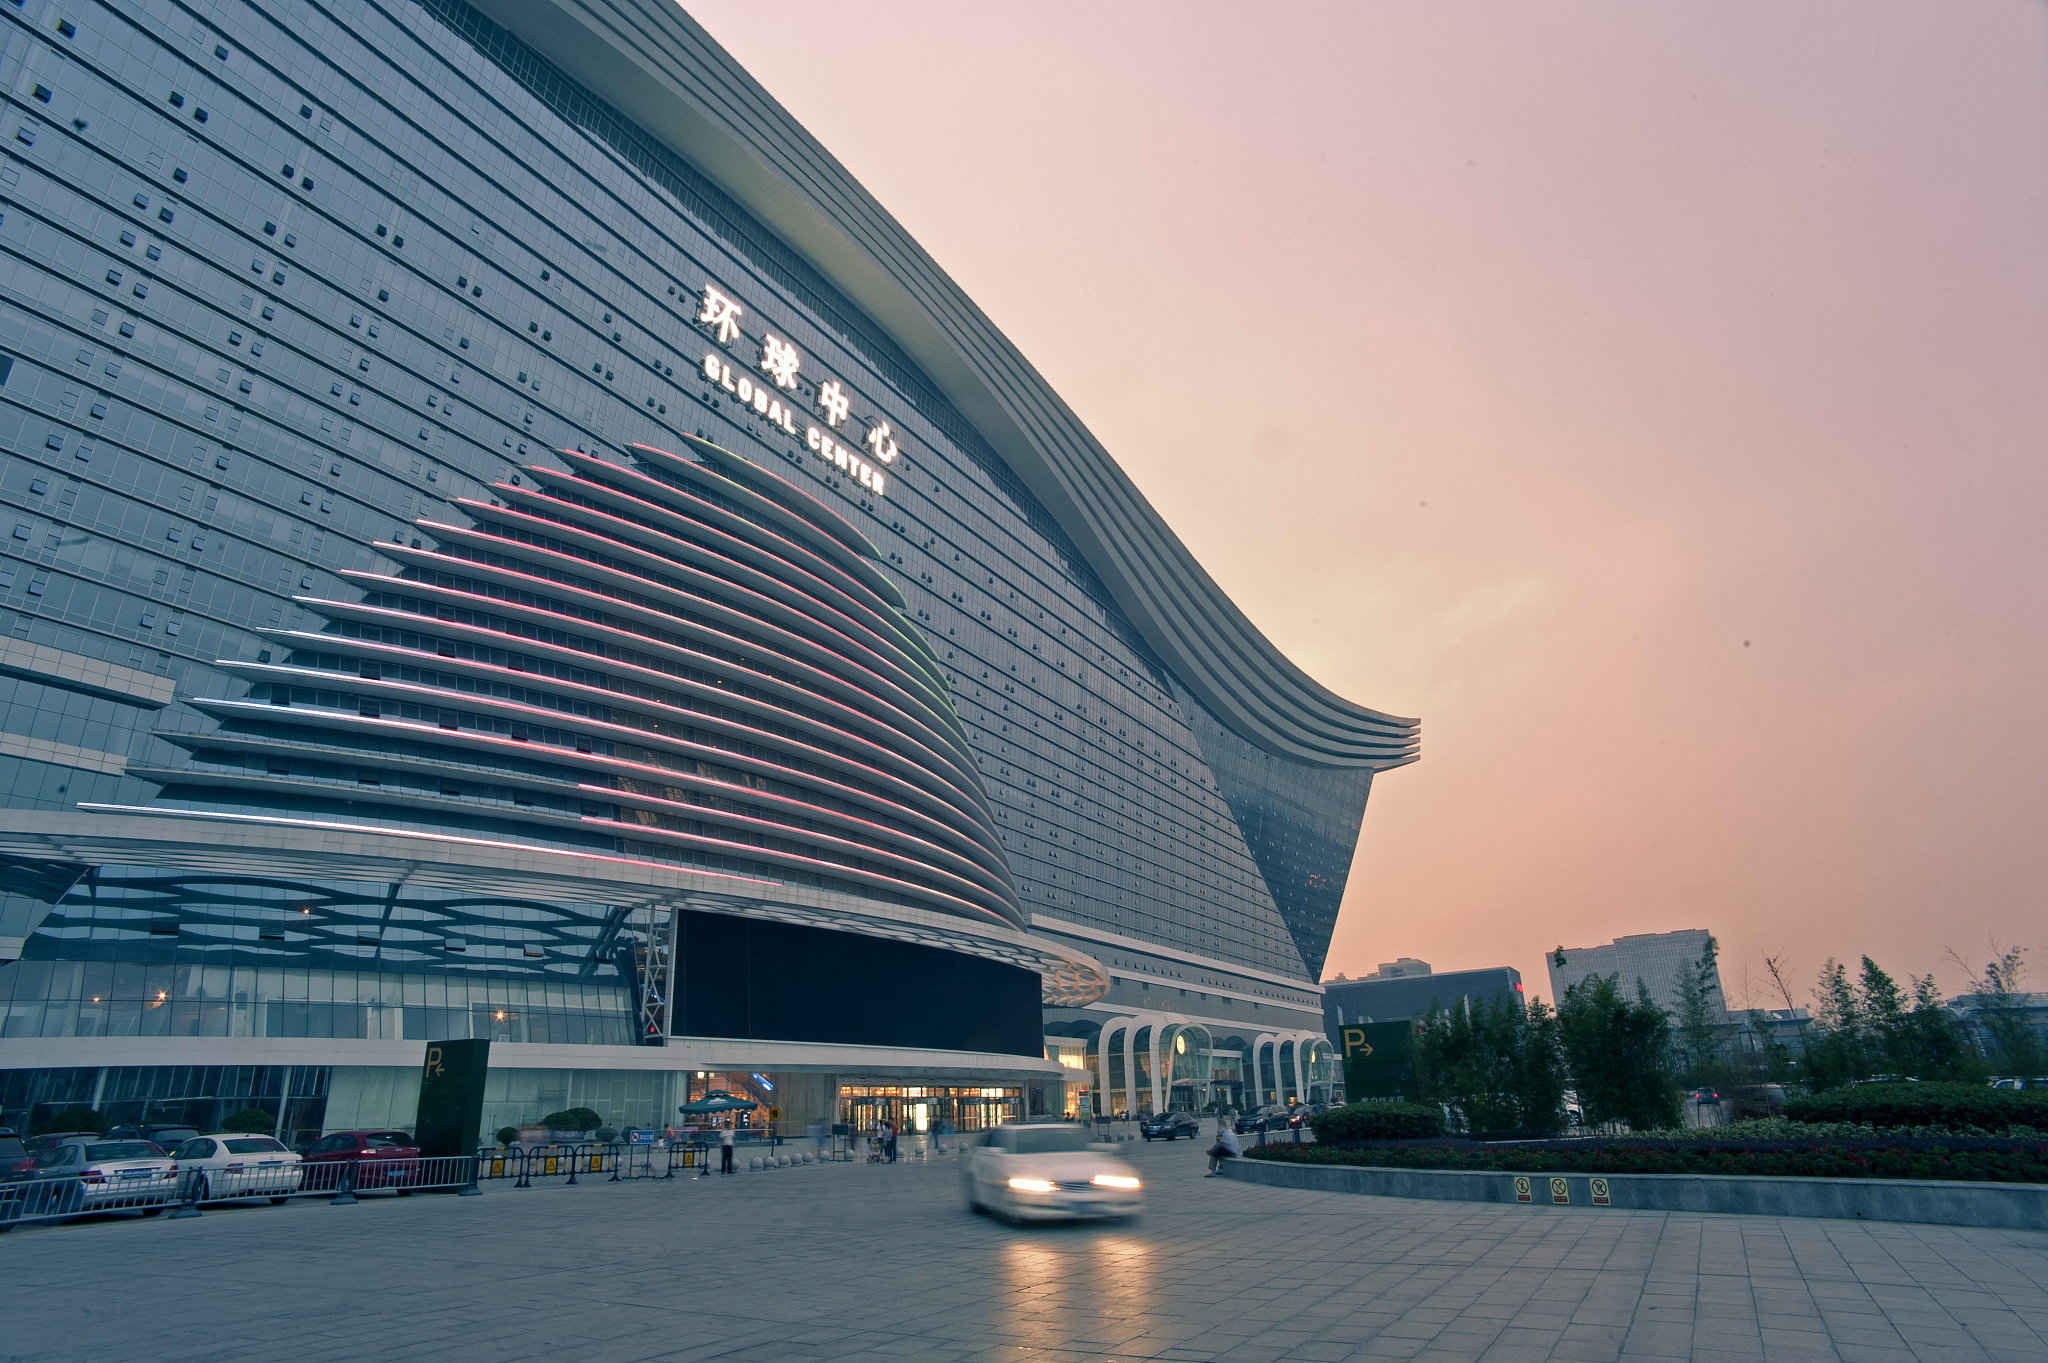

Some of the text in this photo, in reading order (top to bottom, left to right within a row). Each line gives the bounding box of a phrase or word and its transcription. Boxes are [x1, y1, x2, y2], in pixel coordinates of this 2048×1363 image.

[700, 284, 898, 463] 环球中心
[704, 354, 884, 496] GLOBAL CENTER
[425, 1047, 443, 1079] P
[1344, 1028, 1366, 1058] P
